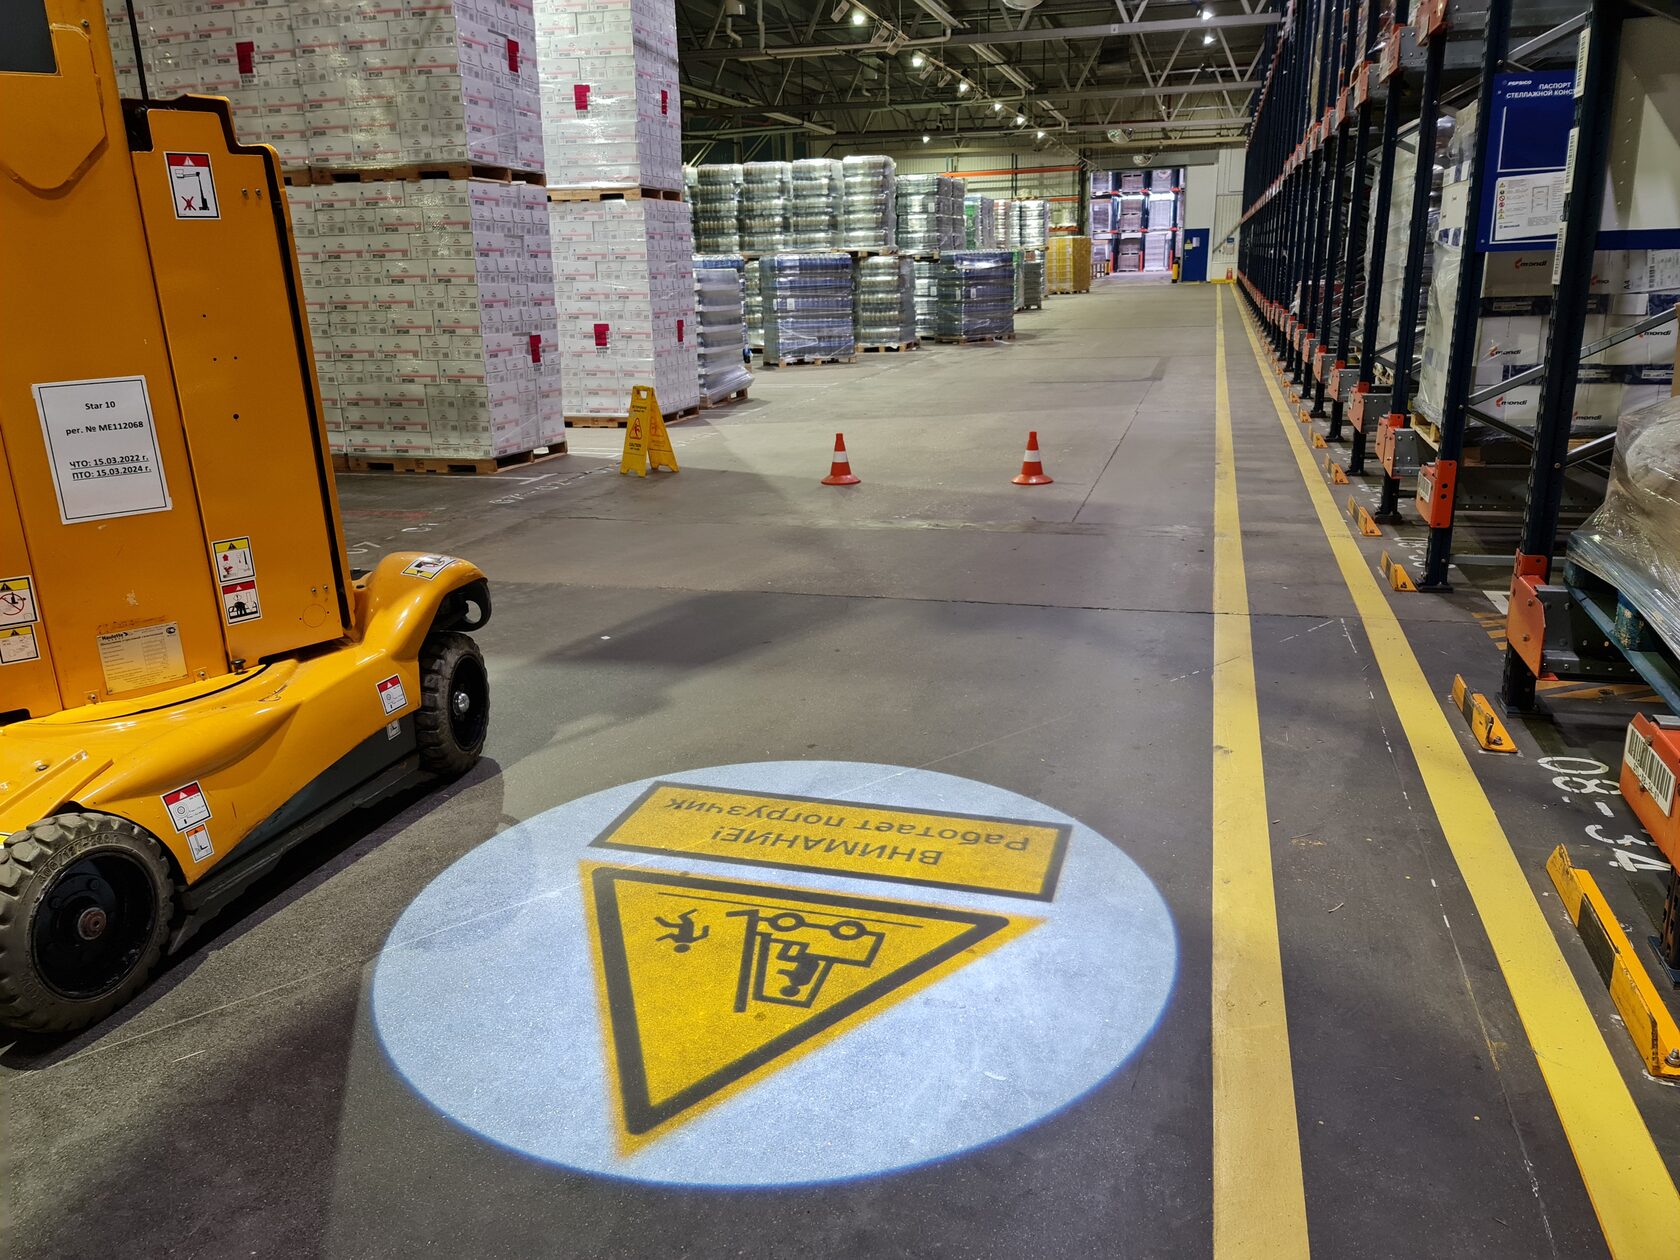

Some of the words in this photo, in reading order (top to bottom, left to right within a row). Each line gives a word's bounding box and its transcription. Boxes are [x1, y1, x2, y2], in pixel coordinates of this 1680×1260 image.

[1539, 82, 1571, 90] ПАСПОРТ
[1506, 90, 1553, 99] СТЕЛЛАЖНОЙ
[85, 402, 103, 410] Star
[105, 401, 116, 409] 10
[66, 428, 84, 436] рег.
[85, 425, 97, 434] №
[69, 459, 92, 468] ЧТО:
[94, 454, 140, 466] 15.03.2022
[72, 470, 95, 479] ПТО:
[97, 465, 143, 477] 15.03.2024
[665, 796, 848, 836] погрузчик
[855, 815, 1031, 853] Работает
[714, 825, 945, 867] ВНИМАНИЕ!
